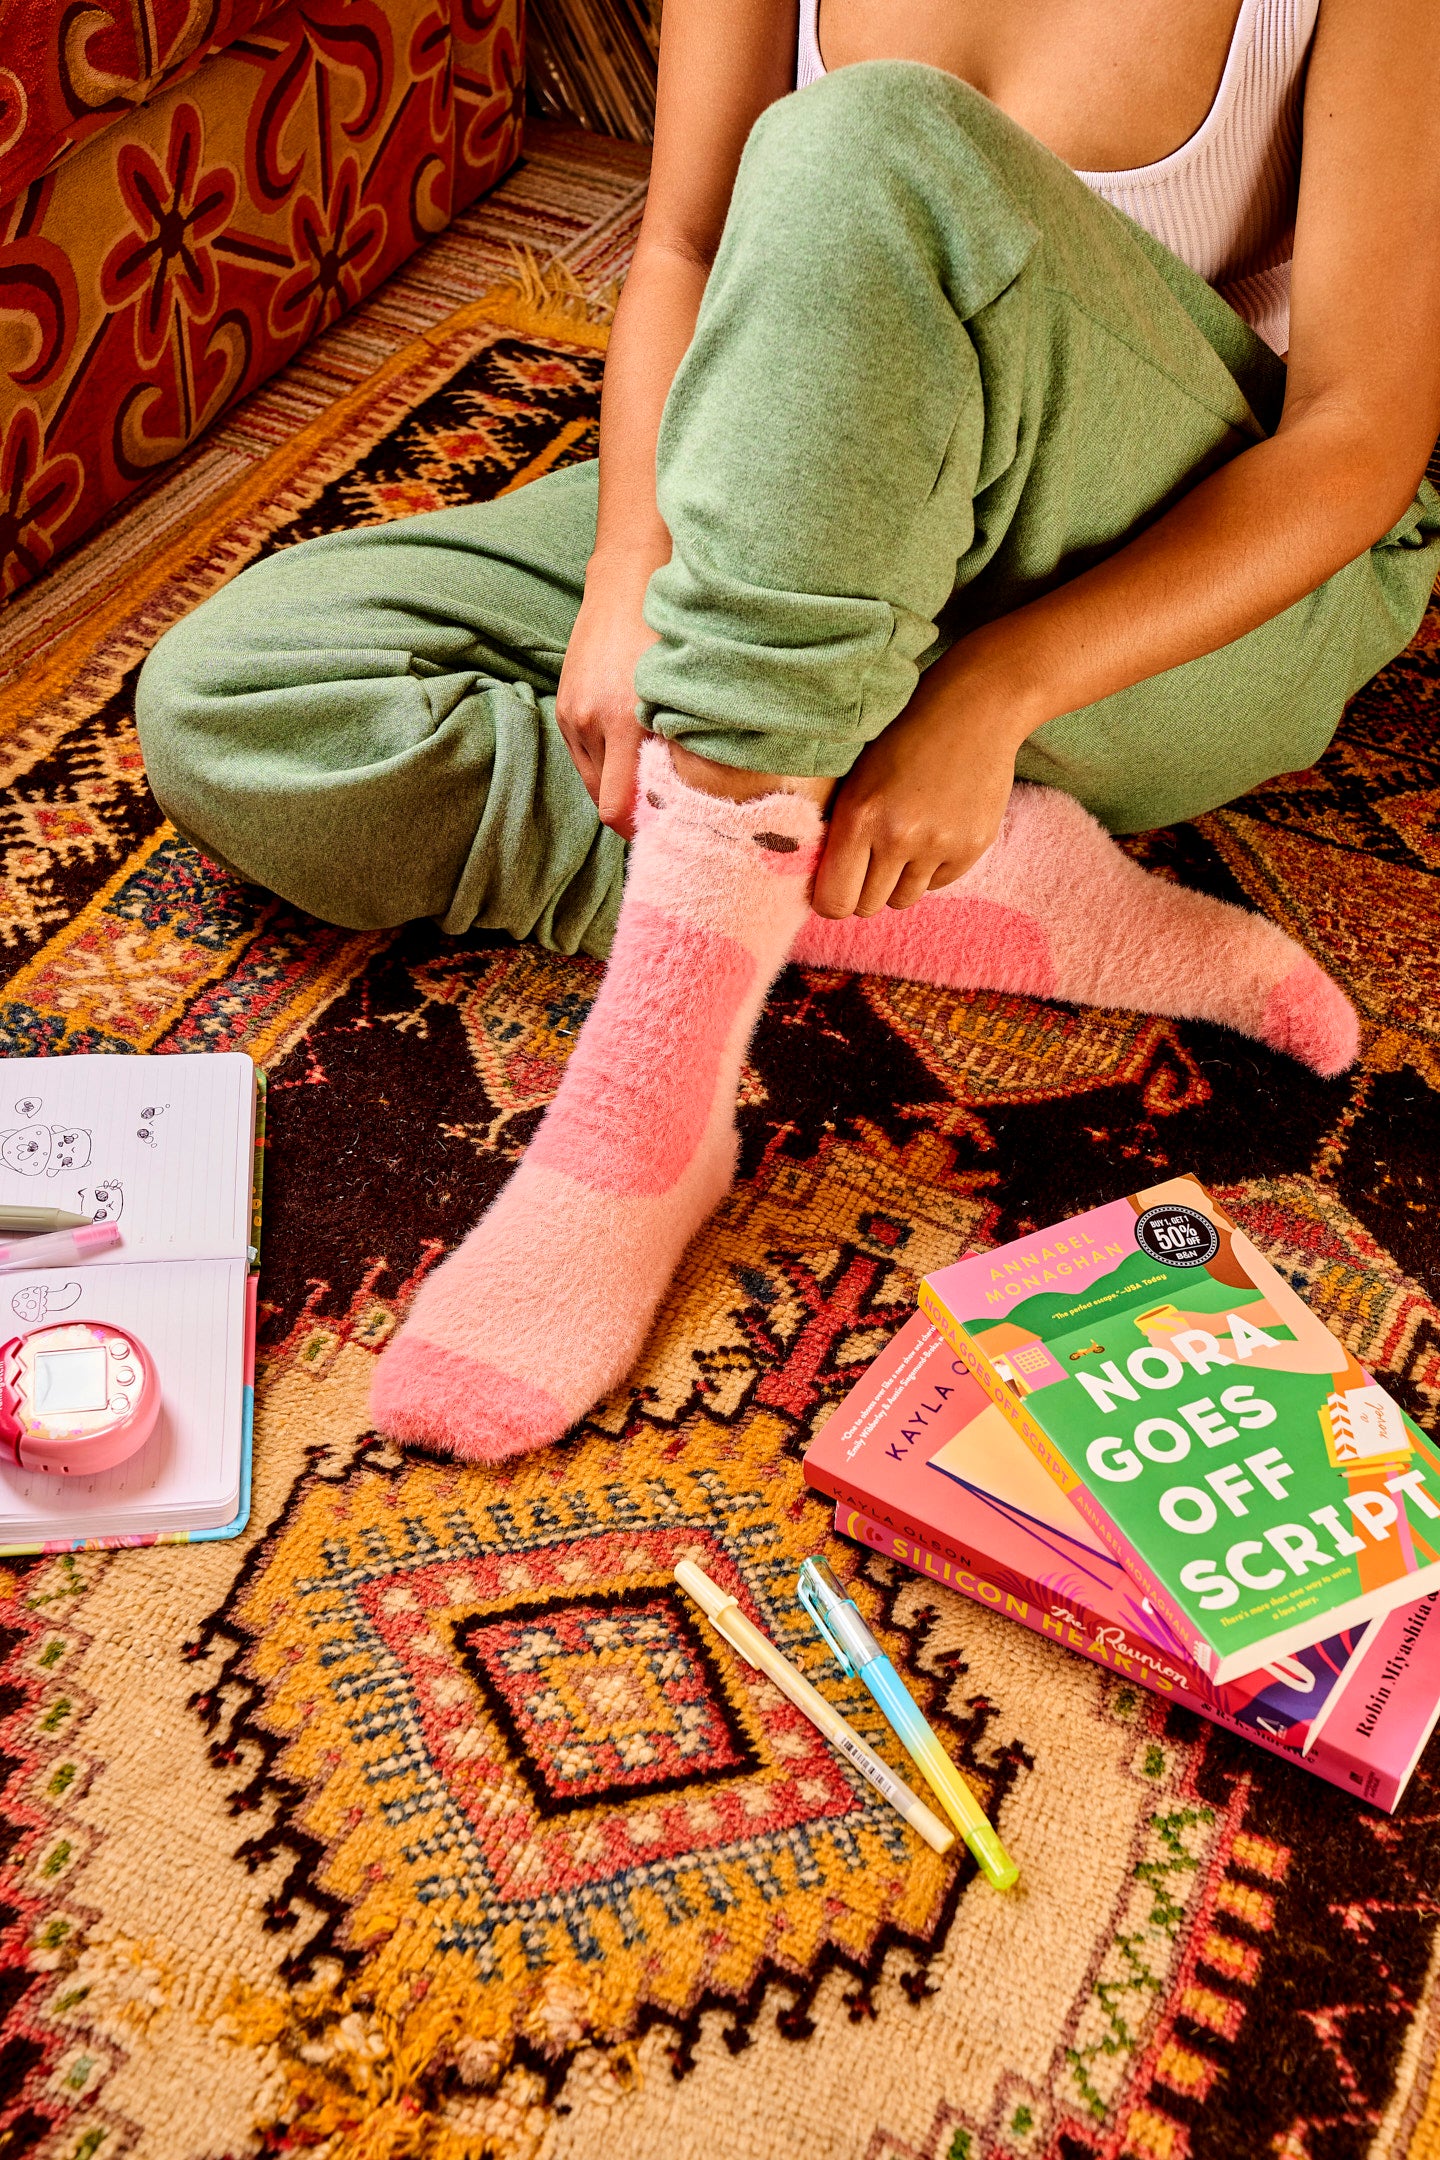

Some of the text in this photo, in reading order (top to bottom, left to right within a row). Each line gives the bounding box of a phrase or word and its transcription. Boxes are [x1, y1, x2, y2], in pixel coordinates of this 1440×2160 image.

[989, 1232, 1095, 1281] ANNABEL
[1149, 1219, 1165, 1228] BUY
[1170, 1215, 1184, 1224] GET
[1153, 1223, 1198, 1250] 50%
[1175, 1250, 1198, 1260] B&N
[1186, 1236, 1200, 1246] OFF
[984, 1242, 1124, 1304] MONAGHAN
[1069, 1300, 1093, 1316] perfect
[1141, 1273, 1168, 1286] Today
[861, 1400, 877, 1419] obsess
[875, 1387, 886, 1402] over
[881, 1377, 894, 1390] like
[895, 1362, 906, 1375] new
[903, 1350, 916, 1365] show
[914, 1340, 925, 1352] and
[887, 1385, 905, 1405] Austin
[924, 1296, 957, 1344] NORA
[960, 1343, 992, 1387] GOES
[995, 1389, 1019, 1421] OFF
[1022, 1422, 1069, 1485] SCRIPT
[1074, 1313, 1282, 1414] NORA
[885, 1386, 955, 1461] KAYLA
[1085, 1385, 1278, 1482] GOES
[1364, 1401, 1388, 1439] novel
[833, 1488, 972, 1567] KAYLA OLSON
[1159, 1447, 1295, 1534] OFF
[1076, 1496, 1190, 1642] ANNABEL MONAGHAN
[1180, 1469, 1440, 1610] SCRIPT
[892, 1538, 1029, 1620] SILICON
[1250, 1603, 1270, 1616] more
[1270, 1594, 1289, 1606] than
[1290, 1588, 1305, 1599] one
[1305, 1579, 1322, 1592] way
[1331, 1567, 1352, 1579] write
[1278, 1605, 1296, 1617] love
[1050, 1605, 1190, 1690] The Reunion
[1356, 1687, 1391, 1738] Robin
[1381, 1604, 1432, 1685] Miyashita
